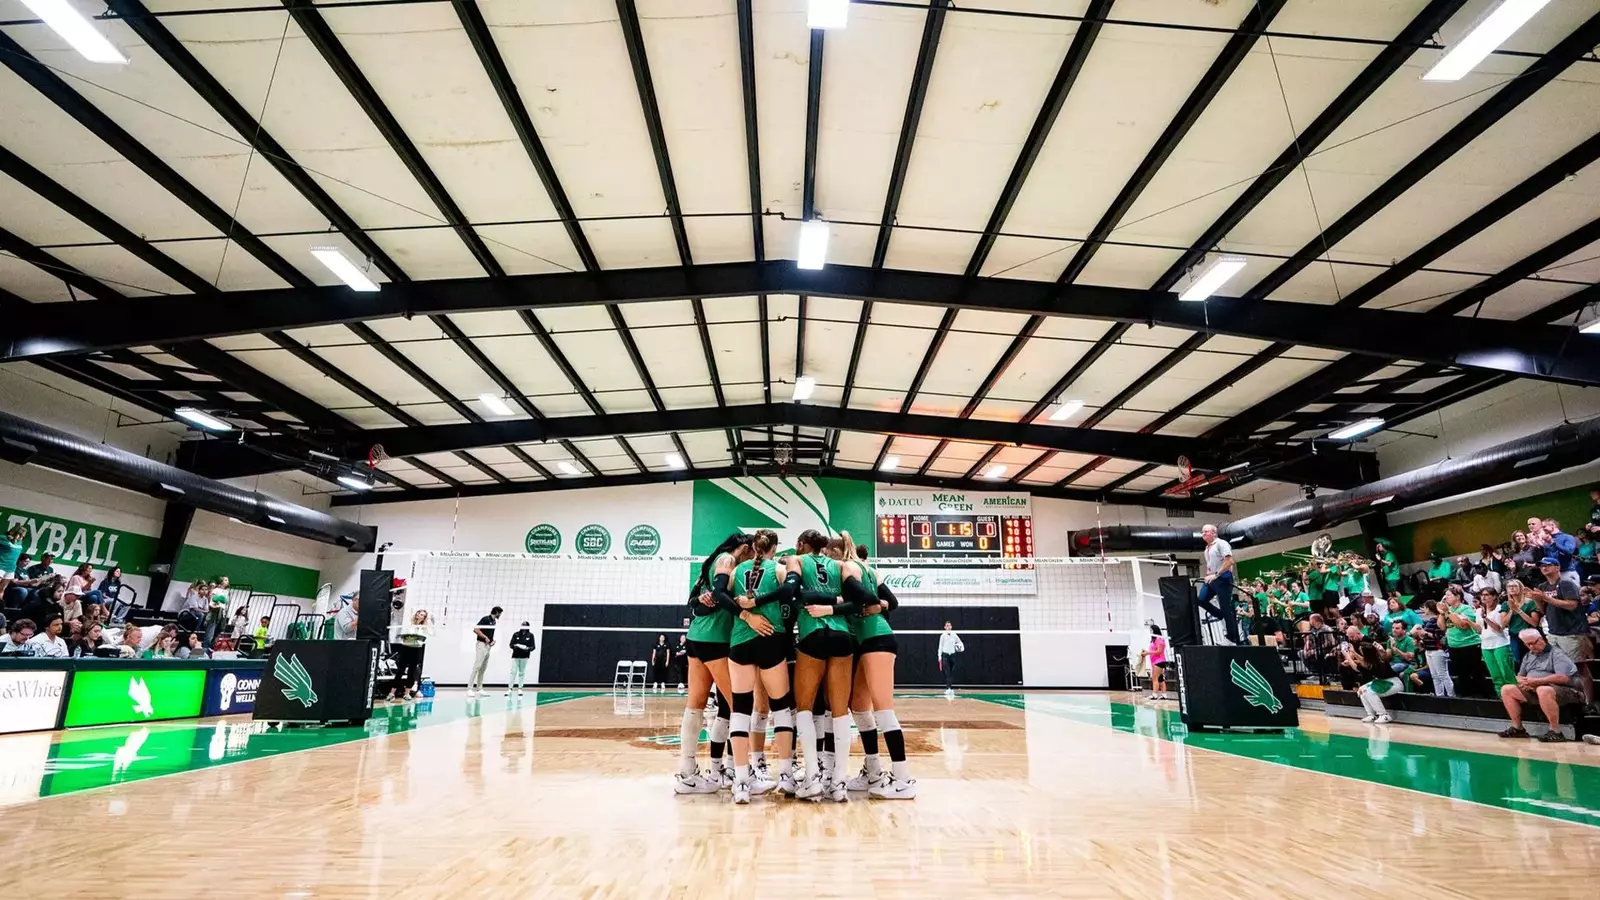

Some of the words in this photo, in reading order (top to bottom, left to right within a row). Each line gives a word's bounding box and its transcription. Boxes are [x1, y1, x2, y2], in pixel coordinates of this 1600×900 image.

[888, 498, 923, 507] DATCU
[932, 493, 965, 503] MEAN
[983, 496, 1027, 505] AMERICAN
[938, 502, 973, 512] GREEN
[531, 525, 558, 536] CHAMPIONS
[580, 525, 607, 536] CHAMPIONS
[921, 523, 929, 535] 0
[948, 523, 971, 536] 1:15
[986, 523, 994, 536] 0
[583, 537, 603, 547] SBC
[922, 536, 931, 549] 0
[979, 537, 988, 549] 0
[815, 563, 829, 585] 5
[780, 604, 791, 619] 8
